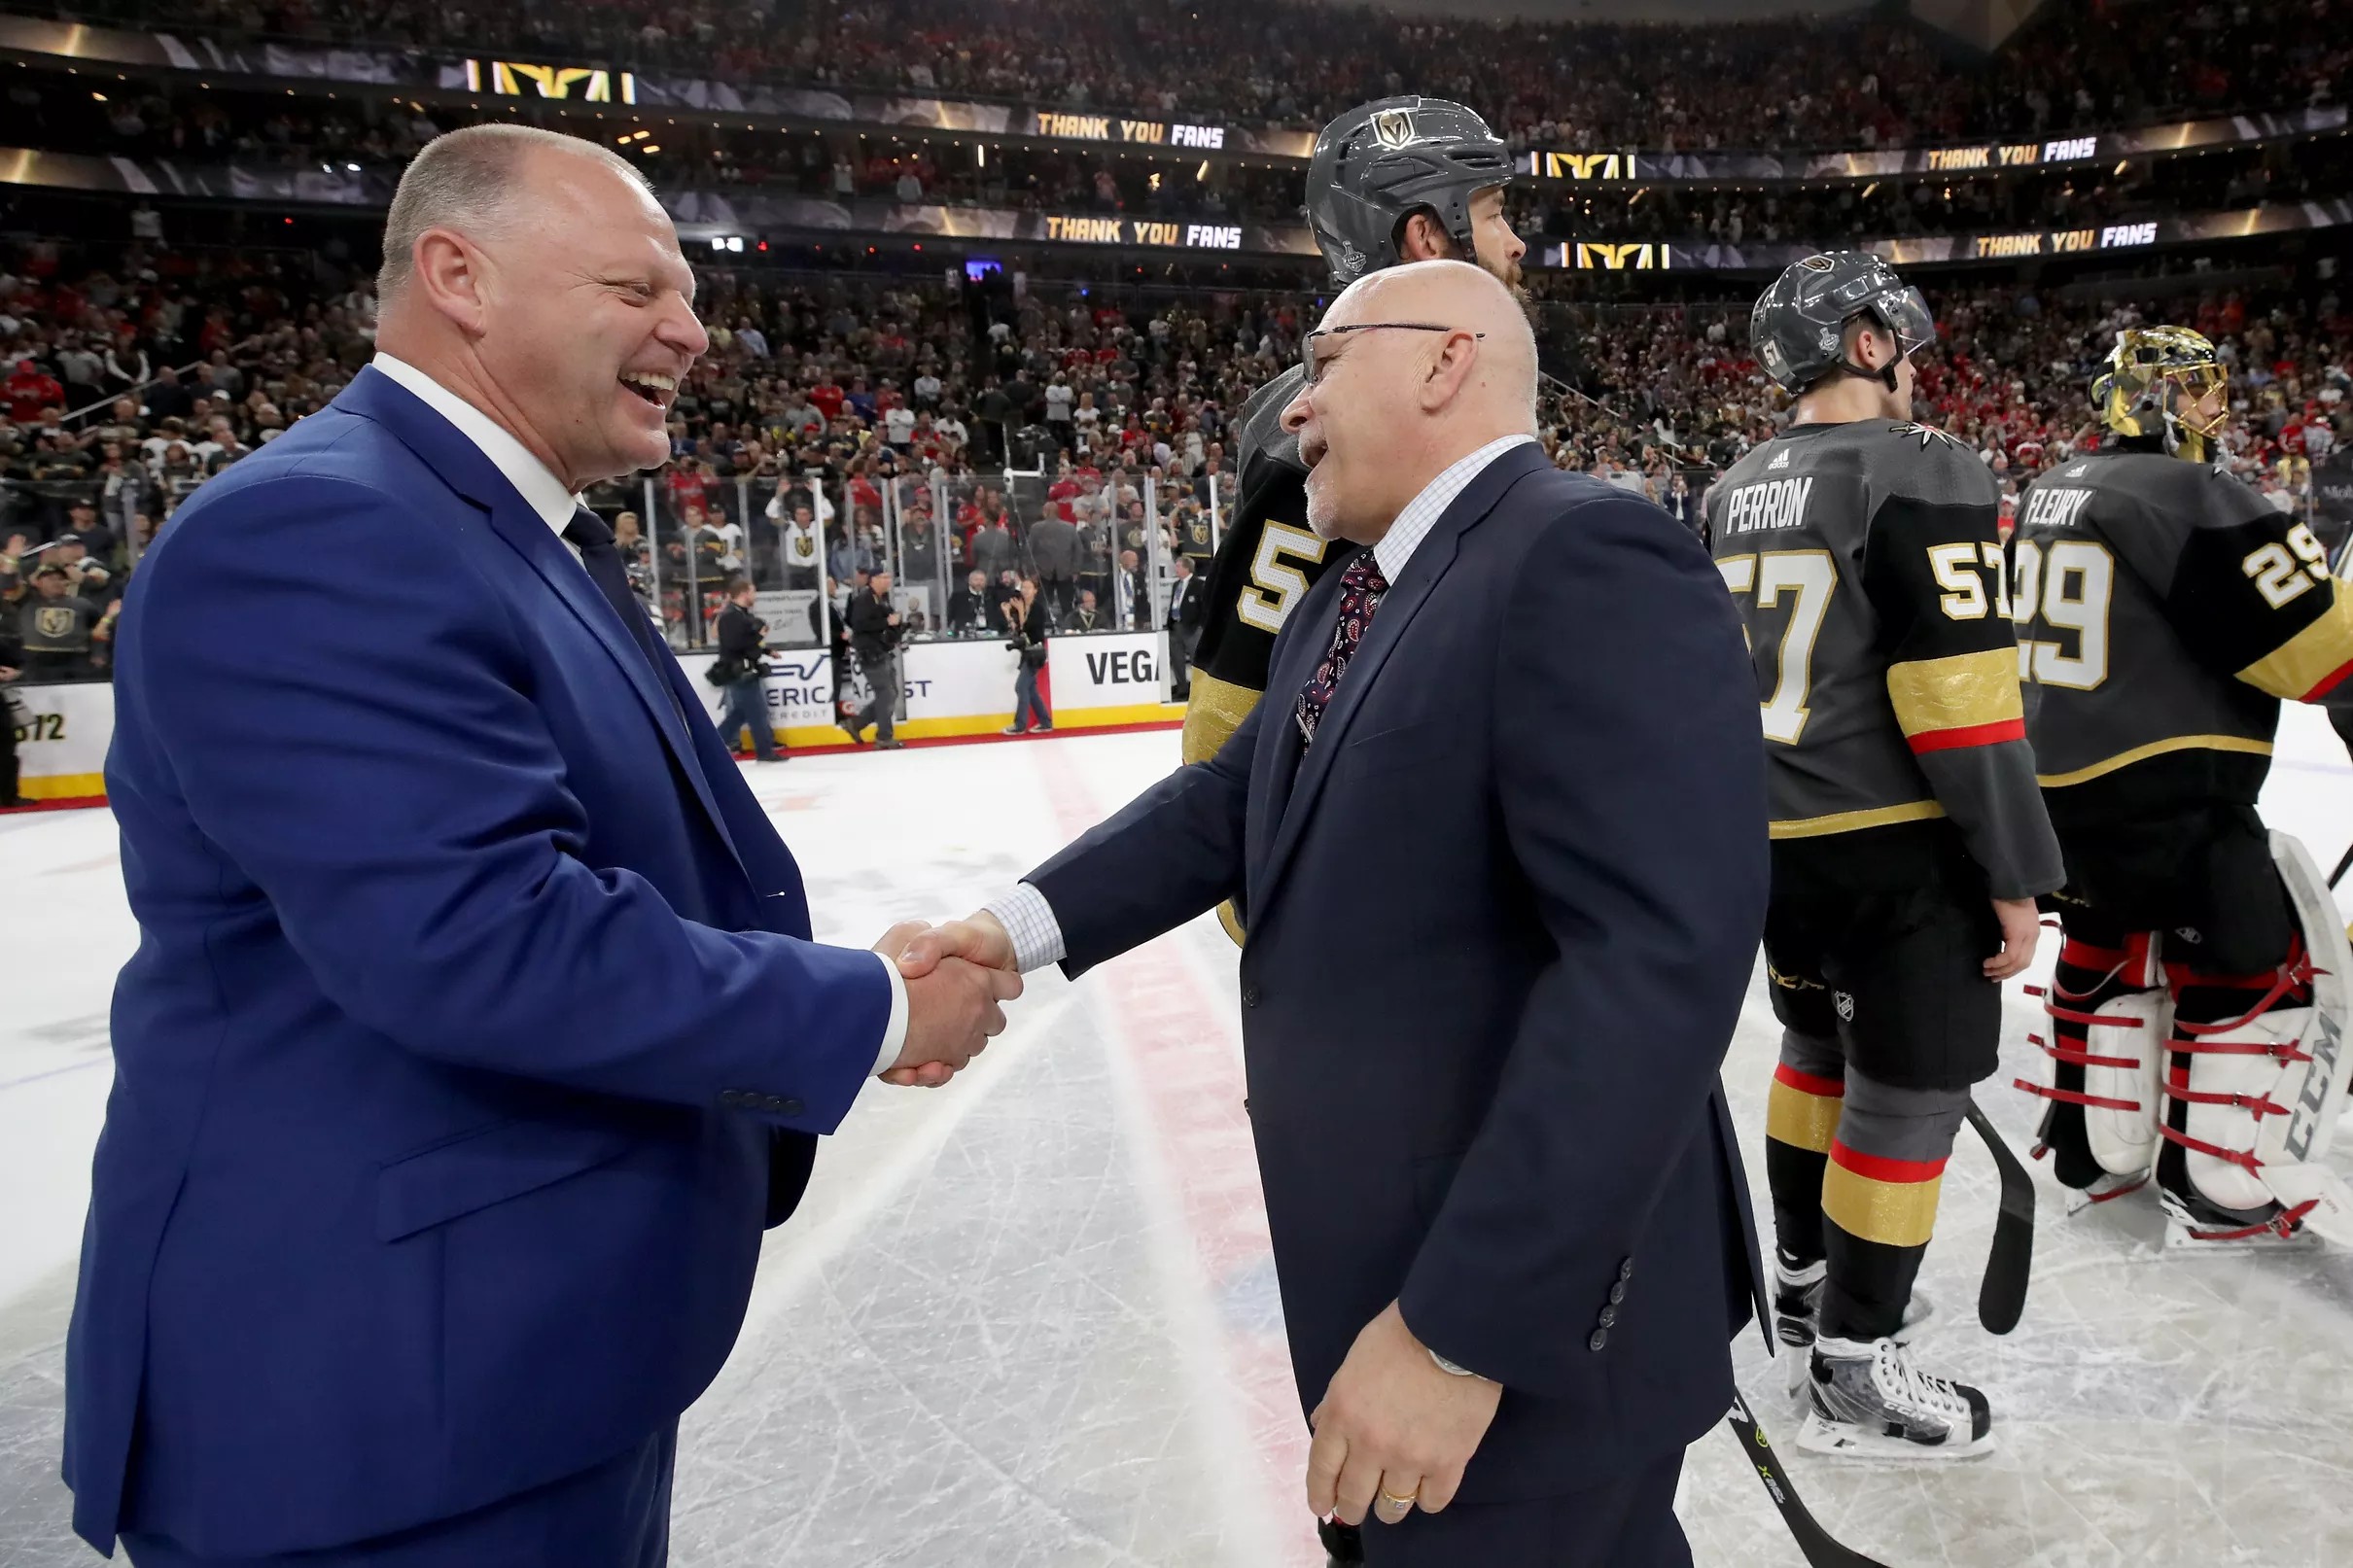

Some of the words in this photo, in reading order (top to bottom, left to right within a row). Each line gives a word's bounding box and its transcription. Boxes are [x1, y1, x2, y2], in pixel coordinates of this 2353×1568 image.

[1037, 113, 1111, 141] THANK
[1120, 119, 1165, 145] YOU
[1171, 124, 1224, 149] FANS
[1928, 147, 1991, 170] THANK
[1998, 145, 2038, 166] YOU
[2043, 137, 2097, 163] FANS
[1046, 217, 1122, 243] THANK
[1133, 222, 1179, 245] YOU
[1186, 225, 1243, 249] FANS
[1977, 233, 2042, 258] THANK
[2051, 229, 2095, 253] YOU
[2100, 223, 2158, 249] FANS
[1726, 477, 1813, 535] PERRON
[2024, 489, 2092, 526] FLEURY
[1237, 519, 1328, 635] 5
[1926, 541, 2014, 621] 57
[2241, 522, 2331, 610] 29
[1085, 649, 1160, 684] VEG
[2283, 1011, 2343, 1162] CCM
